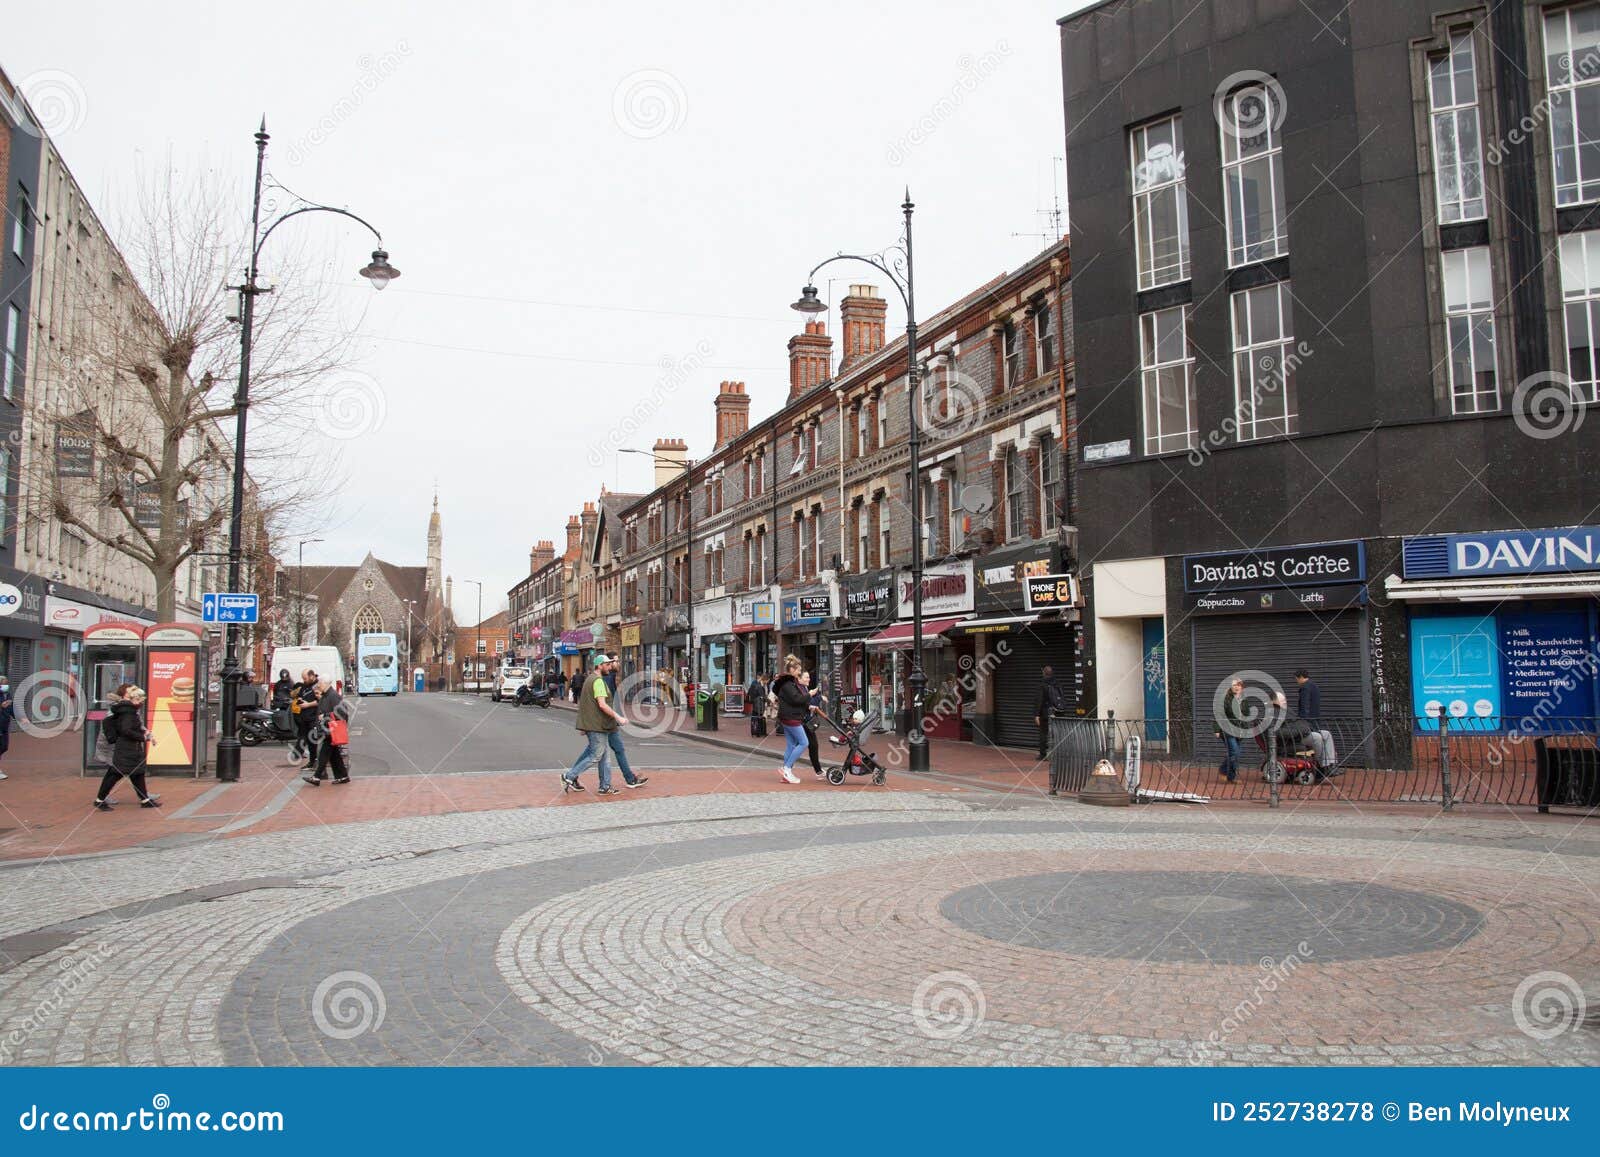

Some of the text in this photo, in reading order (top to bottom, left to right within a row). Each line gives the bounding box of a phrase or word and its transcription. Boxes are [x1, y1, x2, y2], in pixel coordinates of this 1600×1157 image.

[60, 438, 91, 448] HOUSE
[1193, 555, 1350, 583] Davina's Coffee
[1030, 583, 1055, 593] PHONE
[875, 587, 888, 599] VAPE
[1034, 593, 1054, 602] CARE
[1197, 592, 1325, 609] Cappuccino Latte
[1512, 628, 1530, 636] Milk
[1536, 638, 1583, 646] Sandwiches
[1540, 648, 1559, 656] Cold
[152, 662, 185, 671] Hungry?
[1514, 659, 1538, 667] Cakes
[1550, 658, 1580, 666] Biscuits
[1515, 669, 1555, 677] Medicines
[1549, 679, 1569, 687] Films
